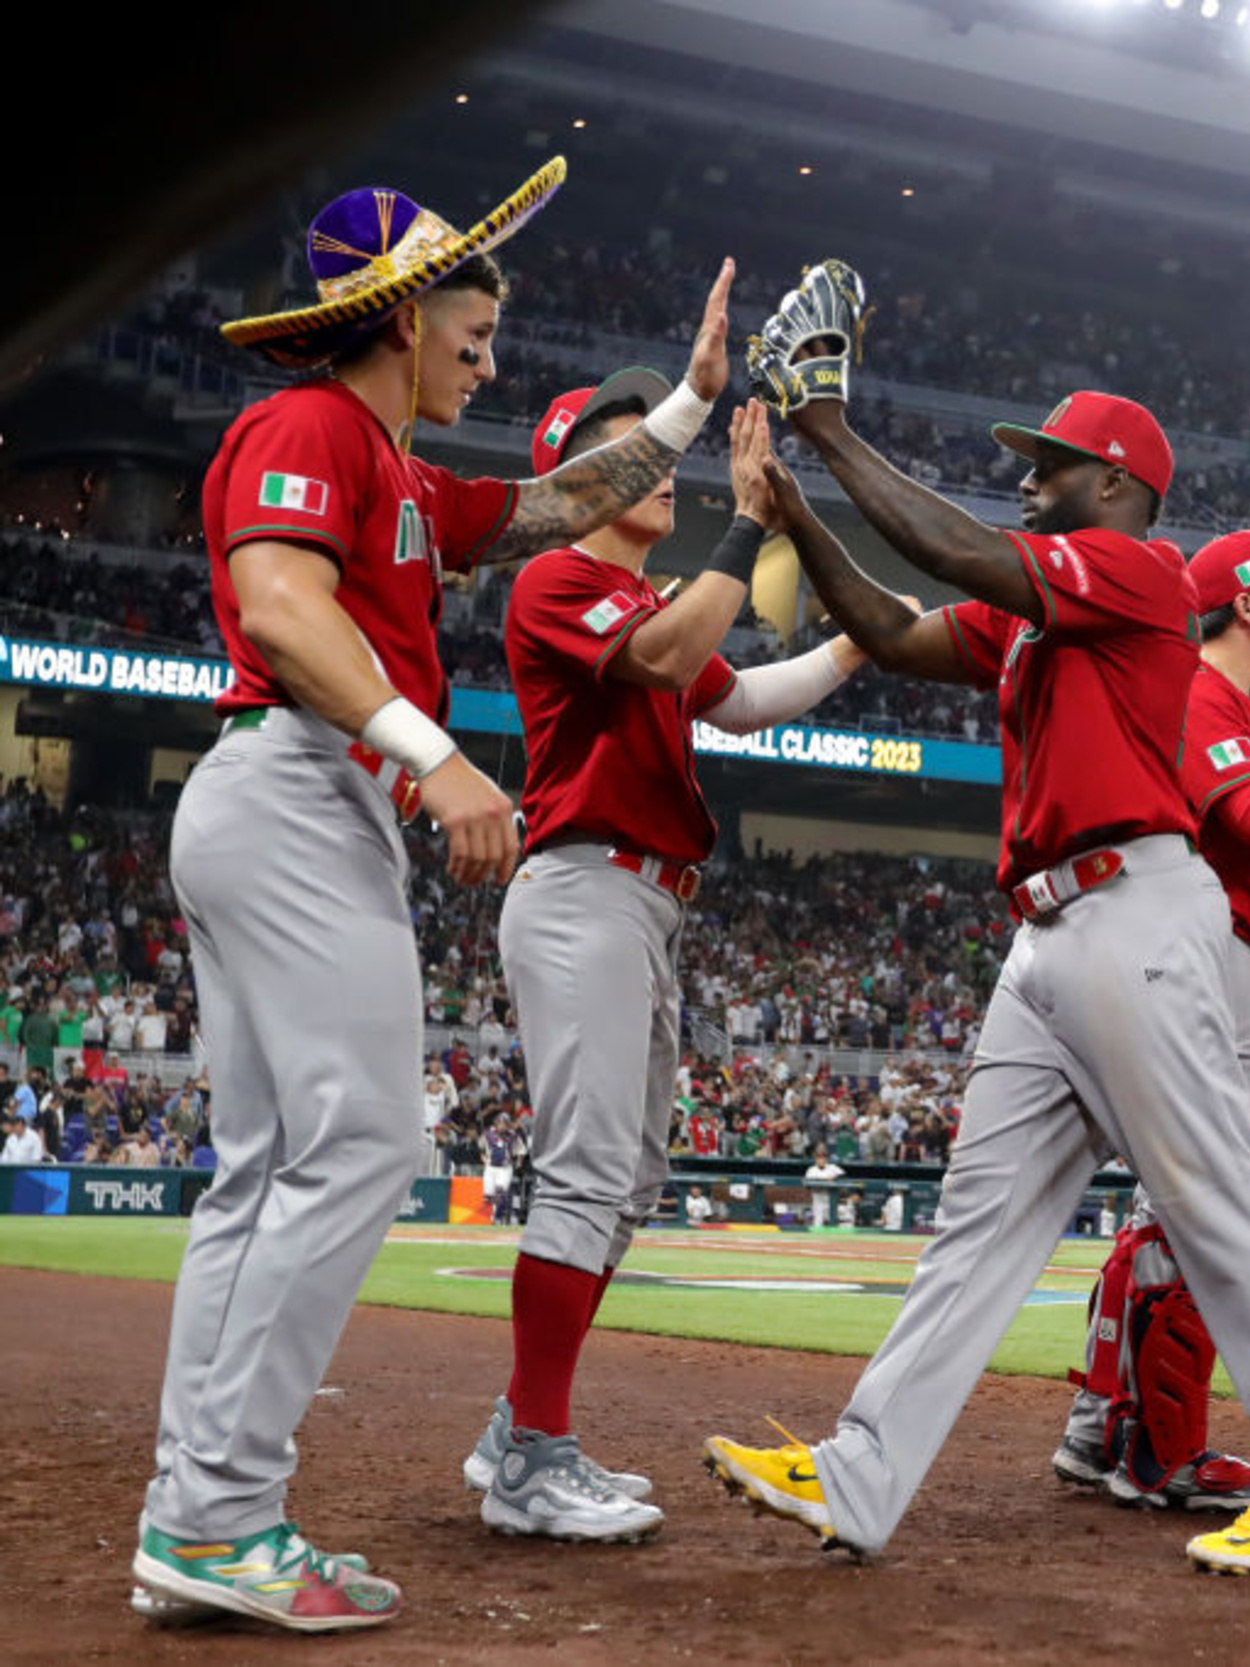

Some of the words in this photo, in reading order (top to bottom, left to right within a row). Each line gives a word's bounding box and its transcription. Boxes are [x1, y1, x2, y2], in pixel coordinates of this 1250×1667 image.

[11, 644, 107, 686] WORLD
[781, 730, 869, 766] CLASSIC
[870, 739, 922, 772] 2023
[84, 1180, 165, 1211] THK
